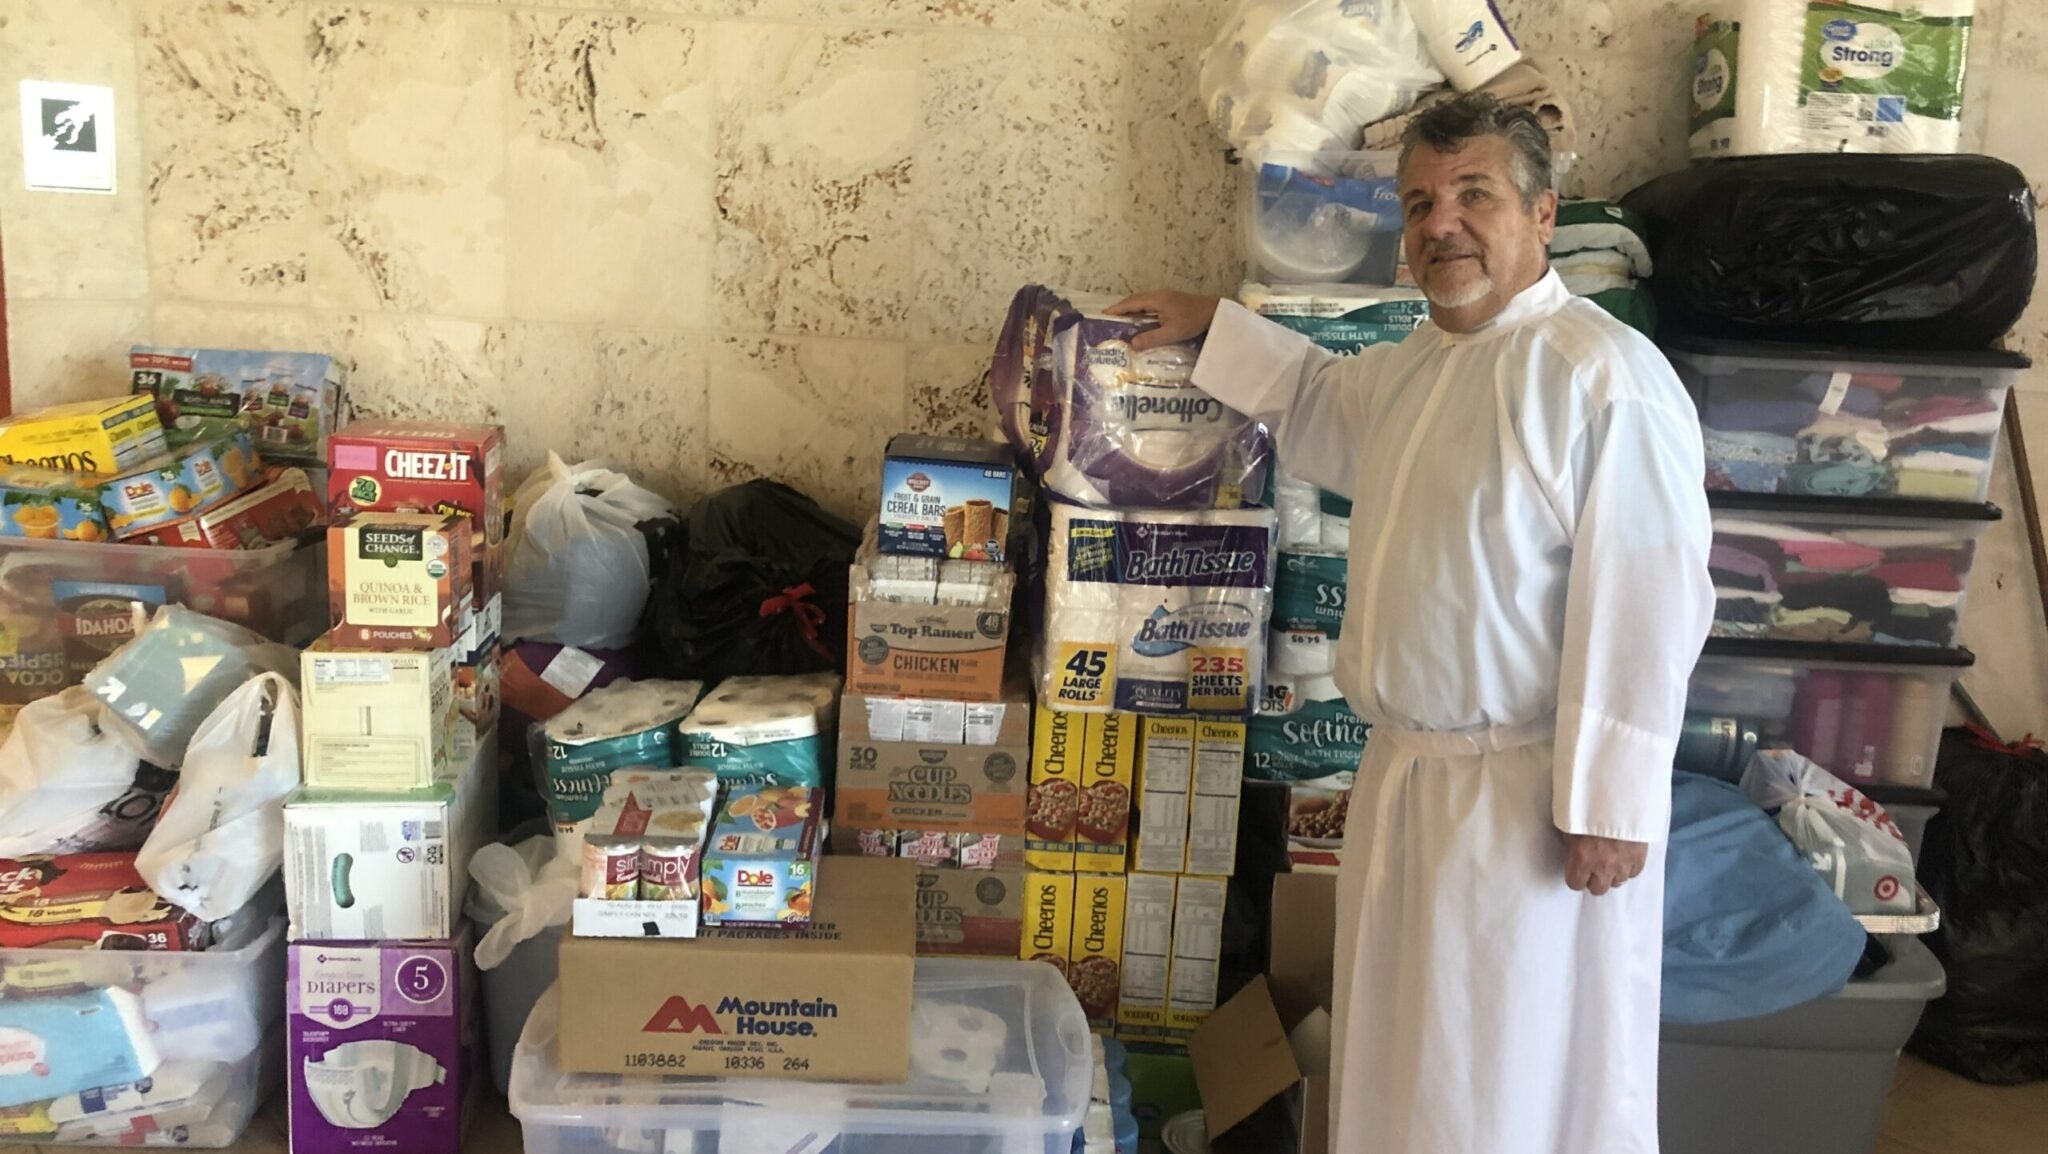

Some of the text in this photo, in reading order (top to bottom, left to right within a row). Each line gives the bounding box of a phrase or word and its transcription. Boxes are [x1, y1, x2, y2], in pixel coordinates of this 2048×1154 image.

[1831, 46, 1893, 67] Strong
[1389, 315, 1412, 323] ROLLS
[1413, 313, 1430, 330] 2
[1310, 330, 1377, 341] BATH TISSUE
[137, 373, 156, 384] 36
[1113, 396, 1223, 423] Cottonelle
[124, 482, 155, 498] Dole
[886, 500, 946, 518] CEREAL BARS
[365, 532, 406, 543] SEEDS
[360, 581, 424, 595] QUINOA &
[353, 593, 432, 606] BROWN RICE
[389, 607, 415, 615] GARLIC
[75, 616, 136, 637] IDAHOA
[985, 614, 1000, 630] 48
[360, 628, 413, 641] 6 POUCHES
[890, 623, 976, 640] Top Ramen
[1291, 635, 1320, 644] $4.95
[893, 654, 959, 673] CHICKEN
[1065, 650, 1108, 677] 45
[1191, 656, 1244, 673] 235
[1062, 676, 1103, 689] LARGE
[1191, 675, 1243, 687] SHEETS
[1133, 686, 1182, 699] QUALITY
[1191, 687, 1241, 697] PER ROLL
[1268, 685, 1289, 699] IG
[1260, 691, 1294, 713] OTS!
[1151, 722, 1188, 735] Cheerios
[1202, 725, 1239, 738] Cheerios
[552, 745, 568, 760] 12
[711, 742, 728, 758] 12
[849, 747, 878, 763] 30
[1304, 749, 1361, 760] BATH TISSU
[585, 760, 606, 770] BATH
[849, 762, 877, 770] PACK
[1252, 752, 1271, 768] 12
[908, 765, 957, 784] CUP
[555, 793, 589, 802] Premium
[889, 781, 972, 803] NOODLES
[891, 806, 943, 816] CHICKEN
[647, 850, 693, 882] mply
[790, 863, 804, 875] 16
[737, 869, 774, 886] Dole
[916, 890, 949, 907] UP
[27, 907, 82, 918] 18 Vanilla
[1033, 884, 1057, 950] Cheerios
[1084, 887, 1109, 952] Cheerios
[148, 932, 168, 944] 36
[718, 929, 842, 940] PACKAGES INSIDE
[413, 964, 429, 990] 5
[715, 996, 838, 1018] Mountain
[624, 1053, 810, 1071] 1103882 10336 264
